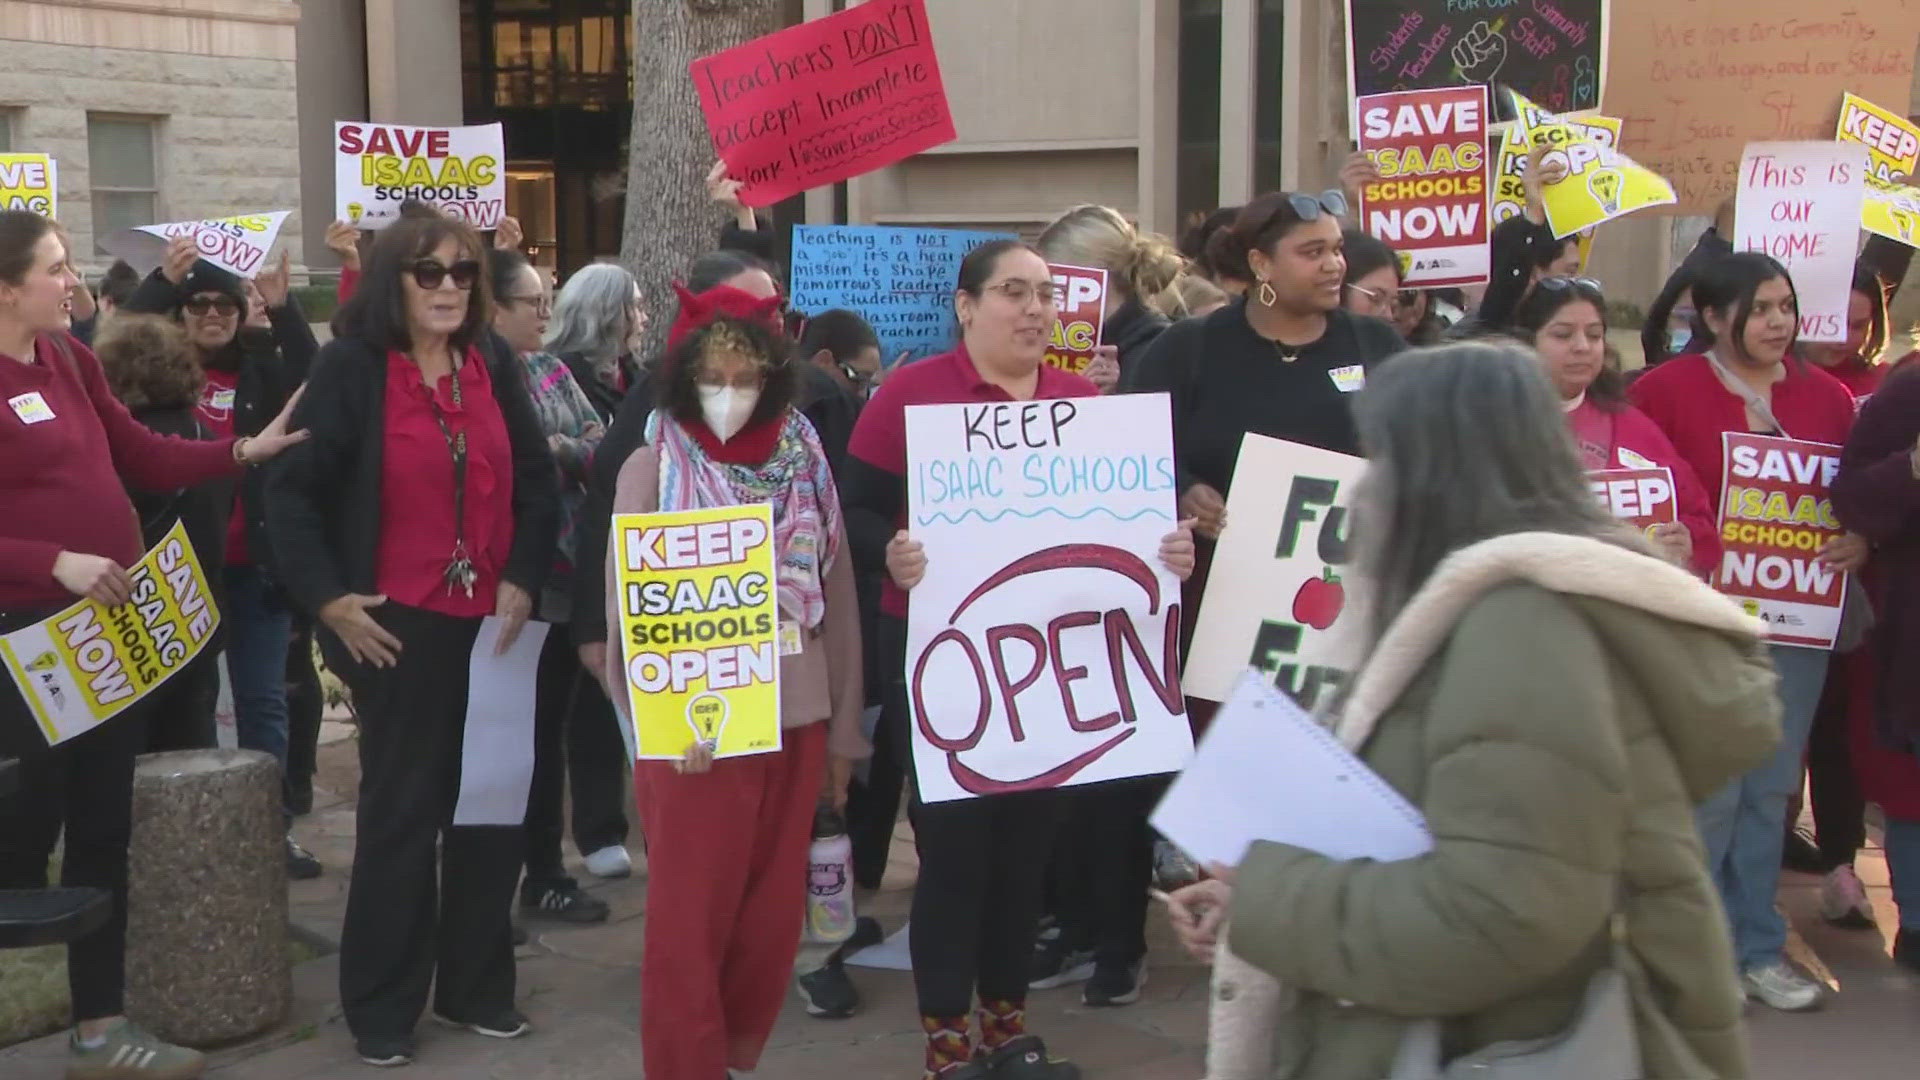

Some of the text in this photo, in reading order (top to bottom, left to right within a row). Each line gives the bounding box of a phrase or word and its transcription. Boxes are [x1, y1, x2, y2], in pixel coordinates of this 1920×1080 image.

[1365, 101, 1480, 139] SAVE
[1844, 104, 1918, 160] KEEP
[339, 125, 450, 158] SAVE
[0, 162, 47, 189] VE
[361, 155, 497, 187] ISAAC
[1366, 176, 1483, 202] SCHOOLS
[1748, 154, 1807, 188] This
[1828, 160, 1852, 185] is
[374, 186, 479, 201] SCHOOLS
[1771, 200, 1815, 223] our
[440, 200, 501, 229] OW
[1370, 203, 1481, 241] NOW
[797, 228, 876, 250] Teaching
[915, 233, 949, 248] NOT
[1747, 231, 1830, 259] HOME
[794, 264, 852, 277] mission
[863, 263, 880, 277] to
[794, 292, 829, 307] Our
[862, 310, 940, 323] lassroom
[963, 400, 1077, 452] KEEP
[919, 452, 1177, 505] ISAAC SCHOOLS
[1731, 445, 1841, 488] SAVE
[624, 518, 768, 572] KEEP
[1720, 549, 1835, 596] NOW
[156, 538, 213, 646] SAVE
[626, 571, 769, 617] ISAAC
[129, 564, 188, 669] ISAAC
[631, 613, 772, 645] SCHOOLS
[56, 605, 137, 706] NOW
[107, 603, 160, 685] CHOOLS
[628, 641, 775, 694] OPEN
[912, 603, 1186, 753] OPEN
